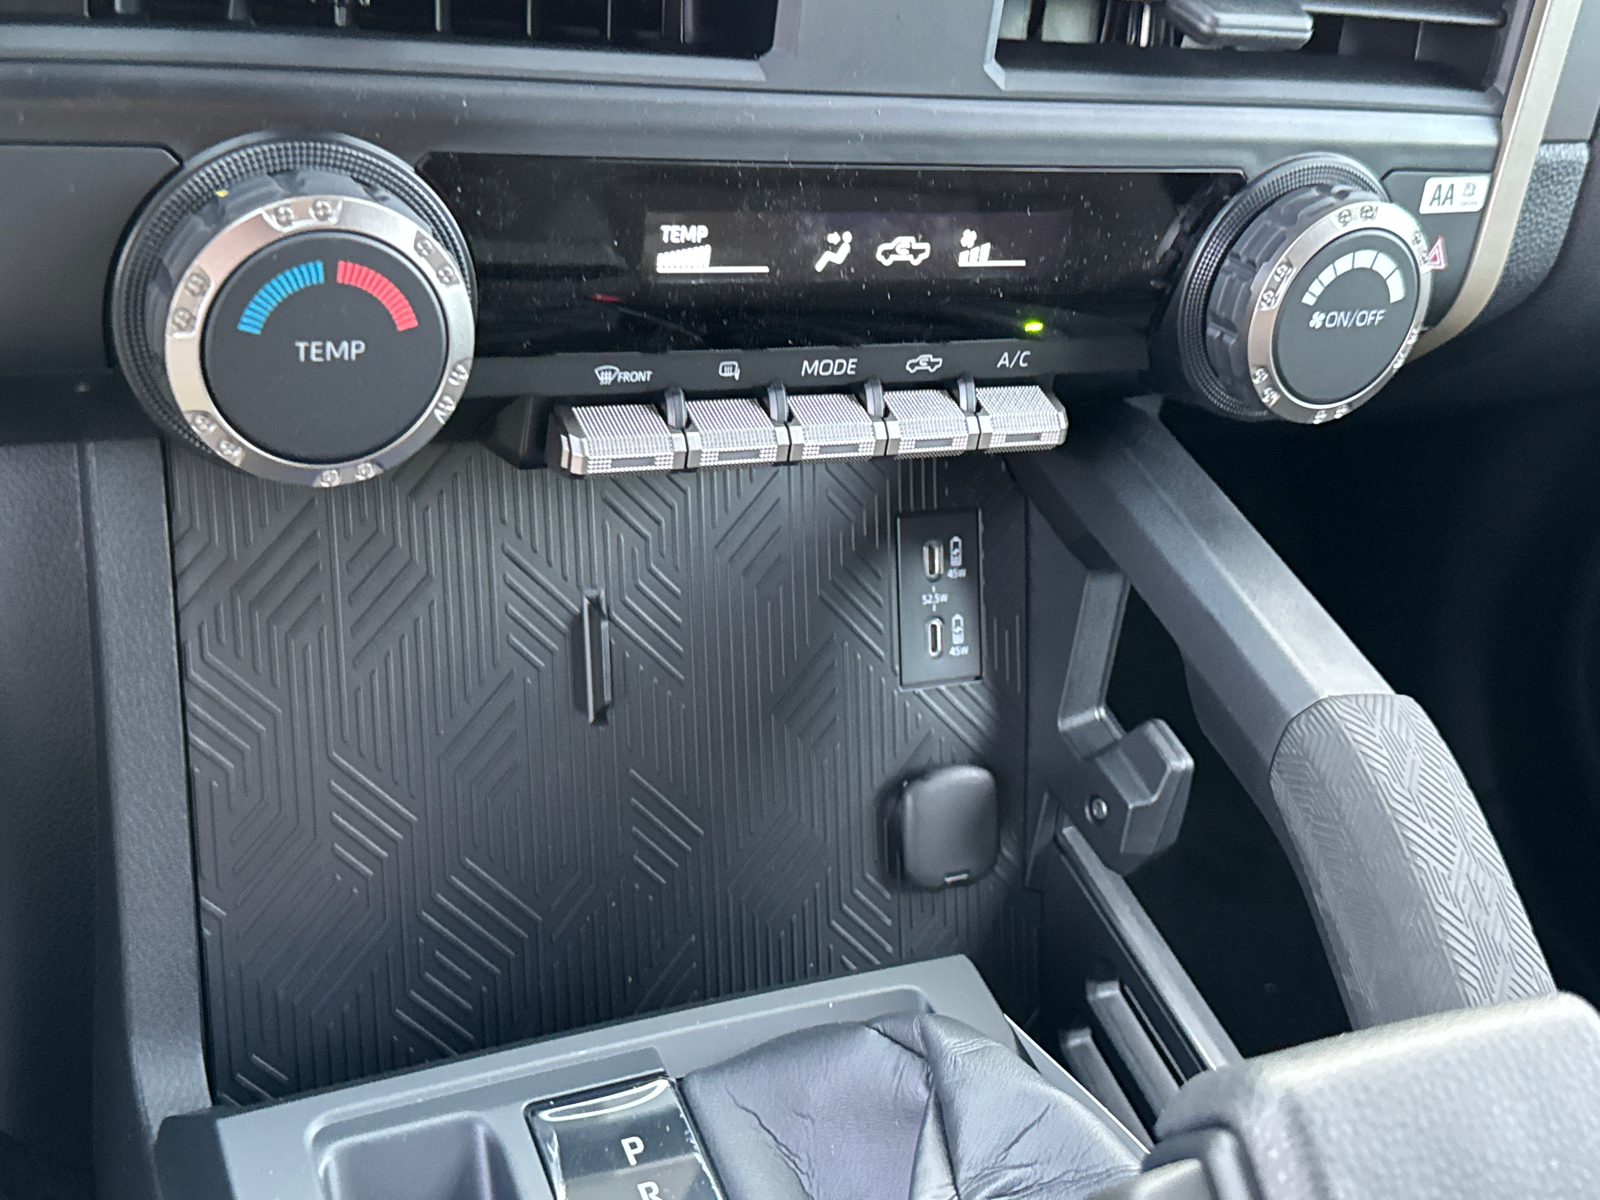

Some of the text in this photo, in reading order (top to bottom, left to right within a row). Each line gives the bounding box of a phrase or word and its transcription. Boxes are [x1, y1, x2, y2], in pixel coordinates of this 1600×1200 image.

[1429, 183, 1455, 207] AA
[660, 224, 709, 244] TEMP
[1325, 309, 1387, 330] ON/OFF
[294, 340, 366, 363] TEMP
[996, 350, 1031, 369] A/C
[617, 370, 653, 383] FRONT
[801, 357, 858, 377] MODE
[947, 567, 967, 579] 45W
[949, 645, 969, 657] 45W
[621, 1136, 645, 1166] P
[637, 1181, 663, 1200] R
